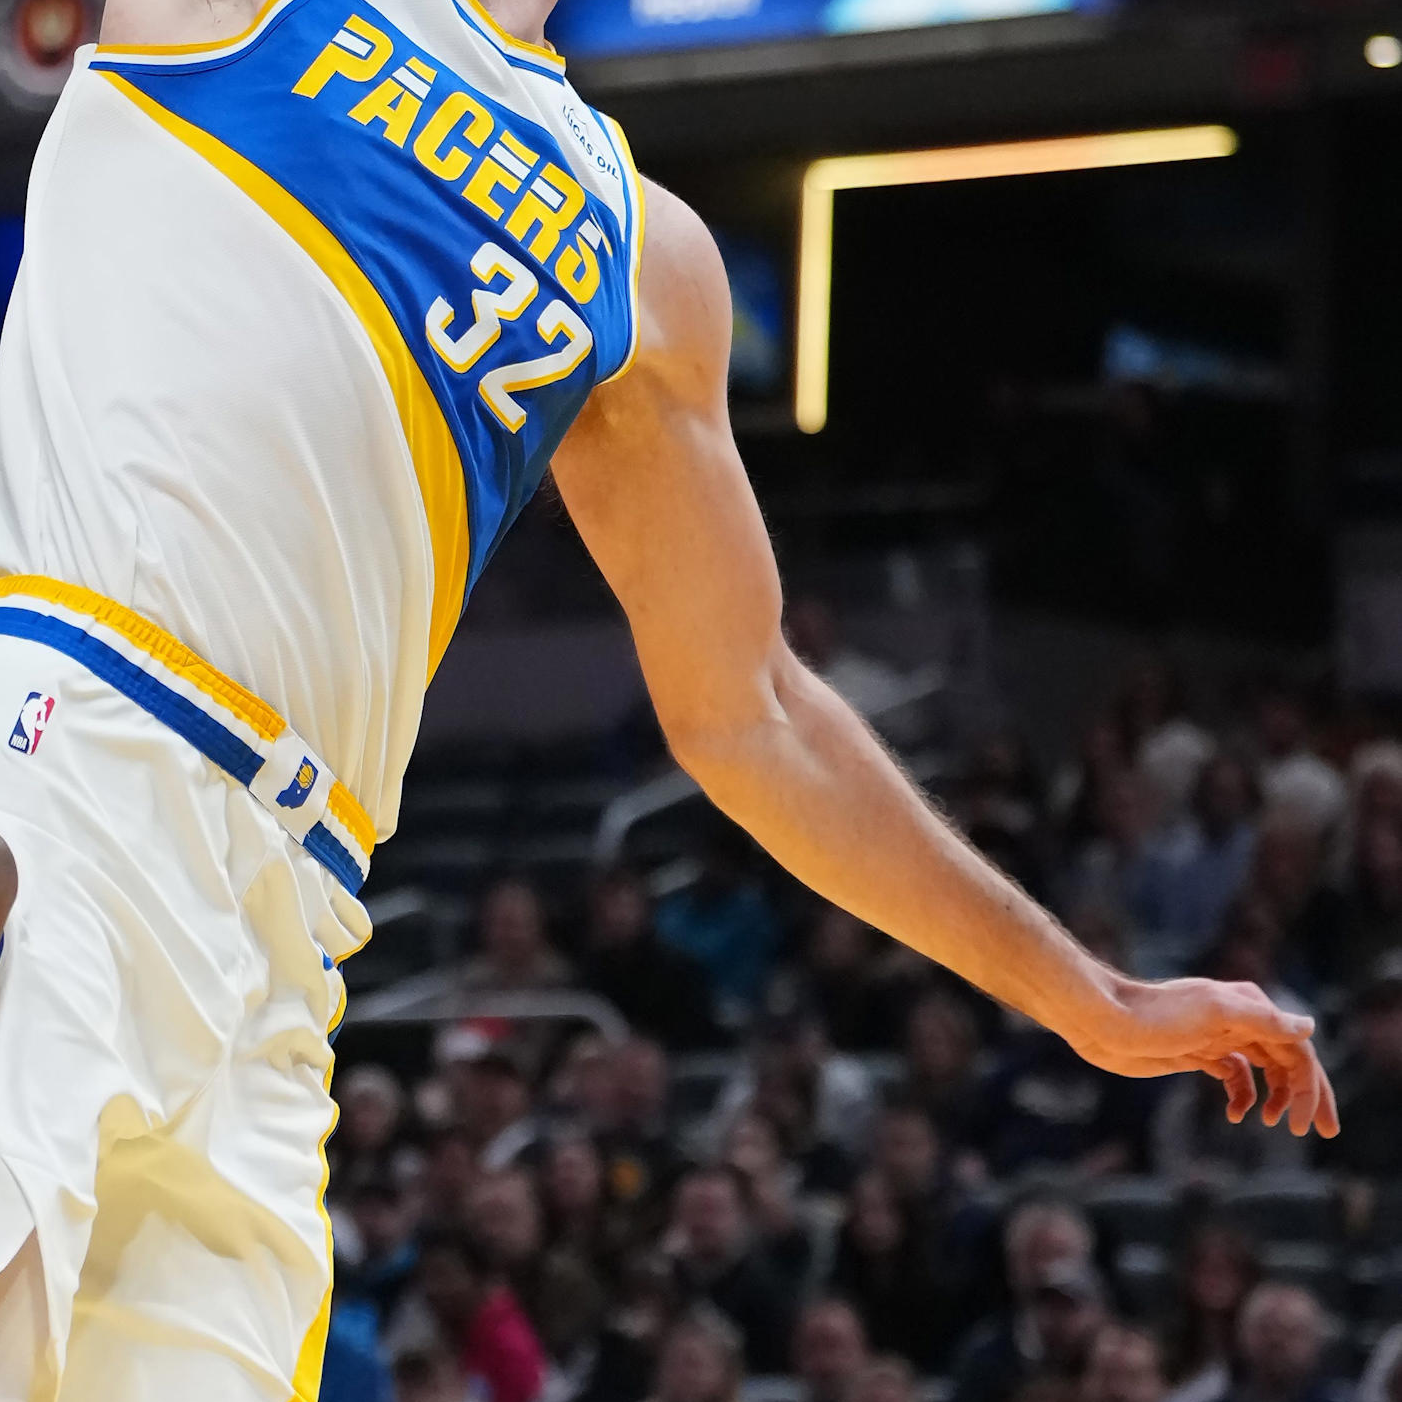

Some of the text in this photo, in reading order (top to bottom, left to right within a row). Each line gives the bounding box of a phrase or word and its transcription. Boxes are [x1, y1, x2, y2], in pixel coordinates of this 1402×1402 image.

[291, 12, 615, 305] PACERS
[597, 156, 619, 180] OIL
[425, 242, 594, 434] 32
[10, 734, 28, 750] NBA
